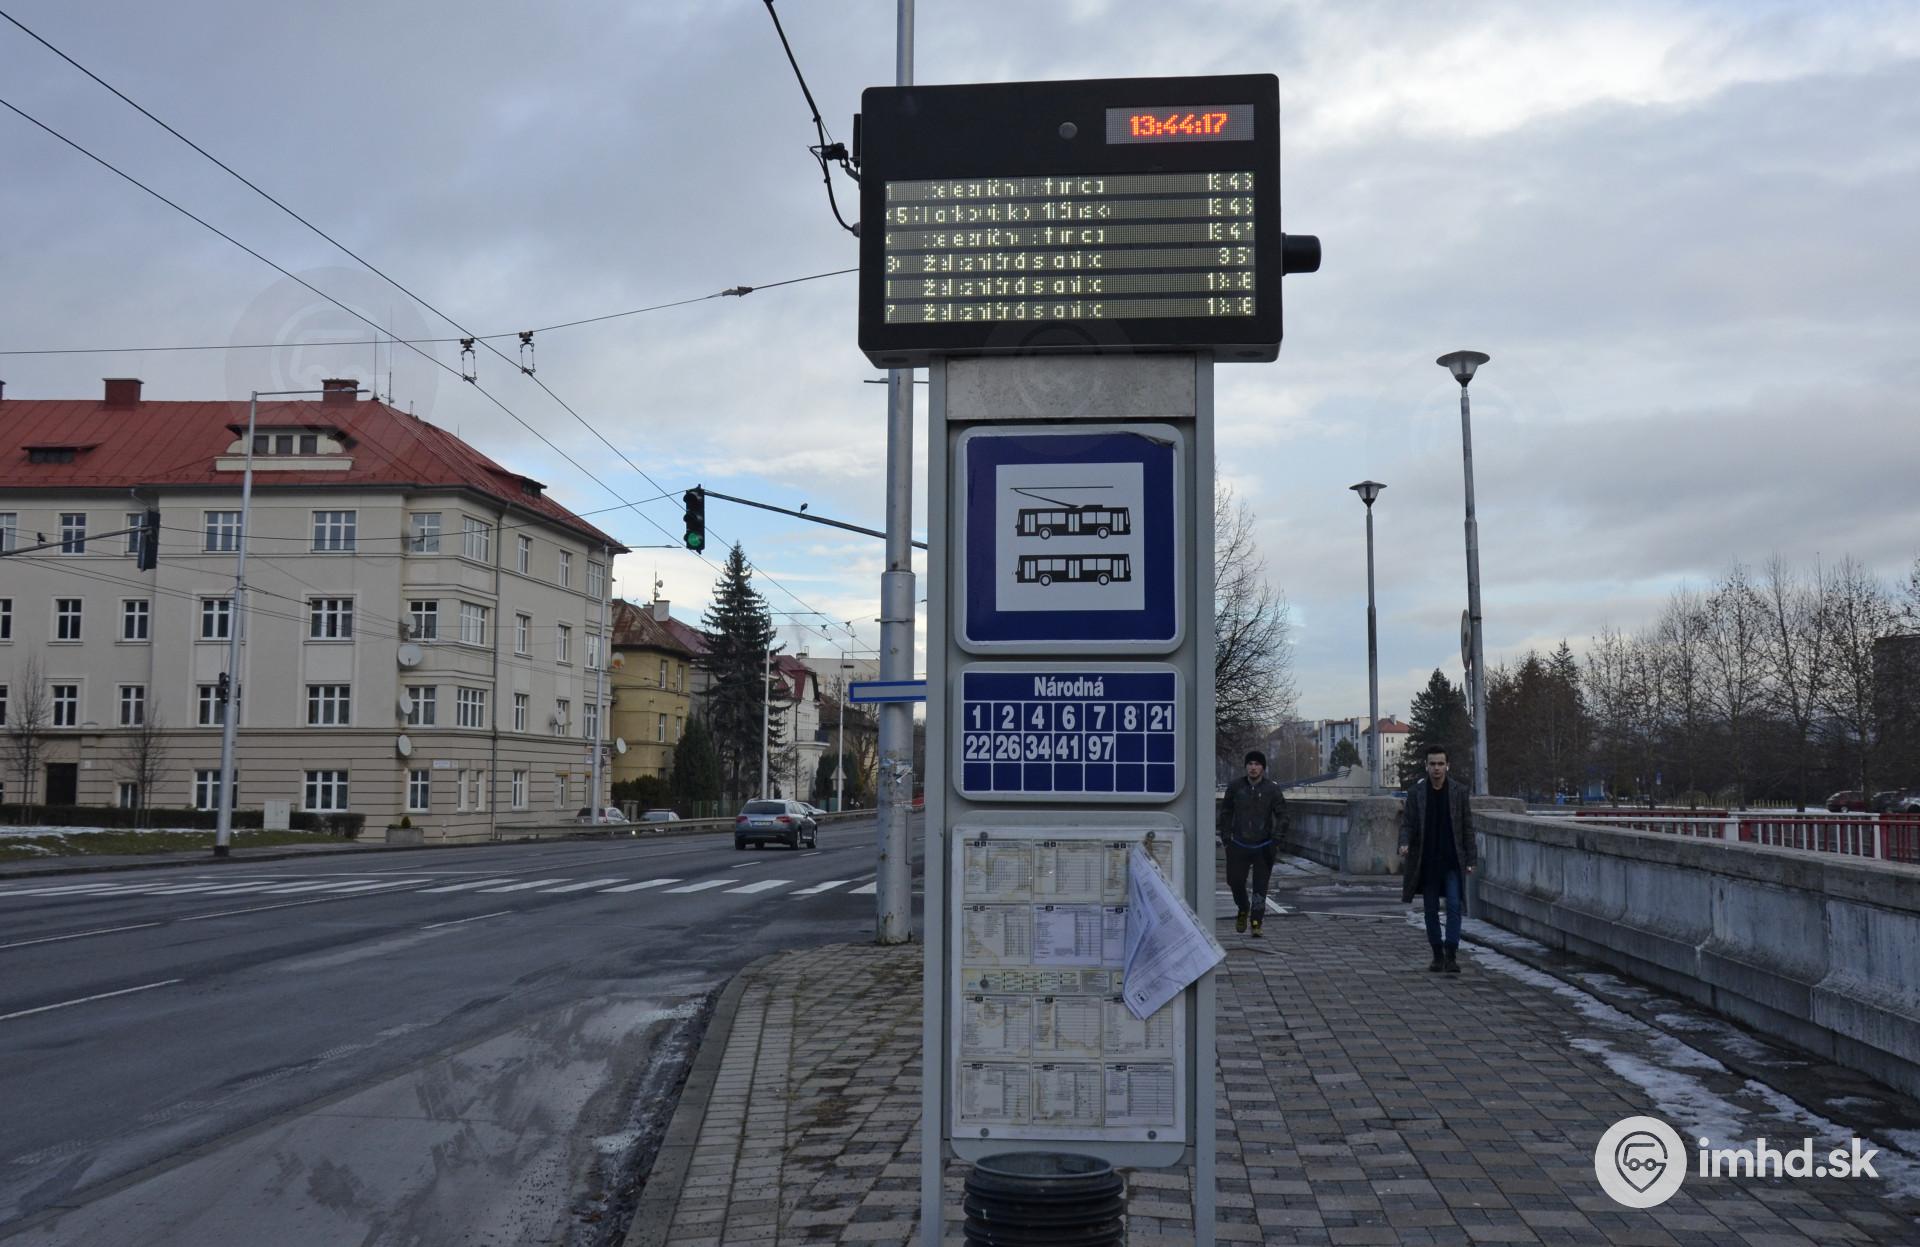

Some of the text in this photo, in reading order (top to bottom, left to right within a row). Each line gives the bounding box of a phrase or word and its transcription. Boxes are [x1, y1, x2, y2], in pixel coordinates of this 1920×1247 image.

[1130, 113, 1228, 136] 13:44:17
[1034, 676, 1104, 697] Národná
[972, 705, 1173, 730] 1 2 4 6 7 8 21
[965, 735, 1114, 760] 22 26 34 41 97
